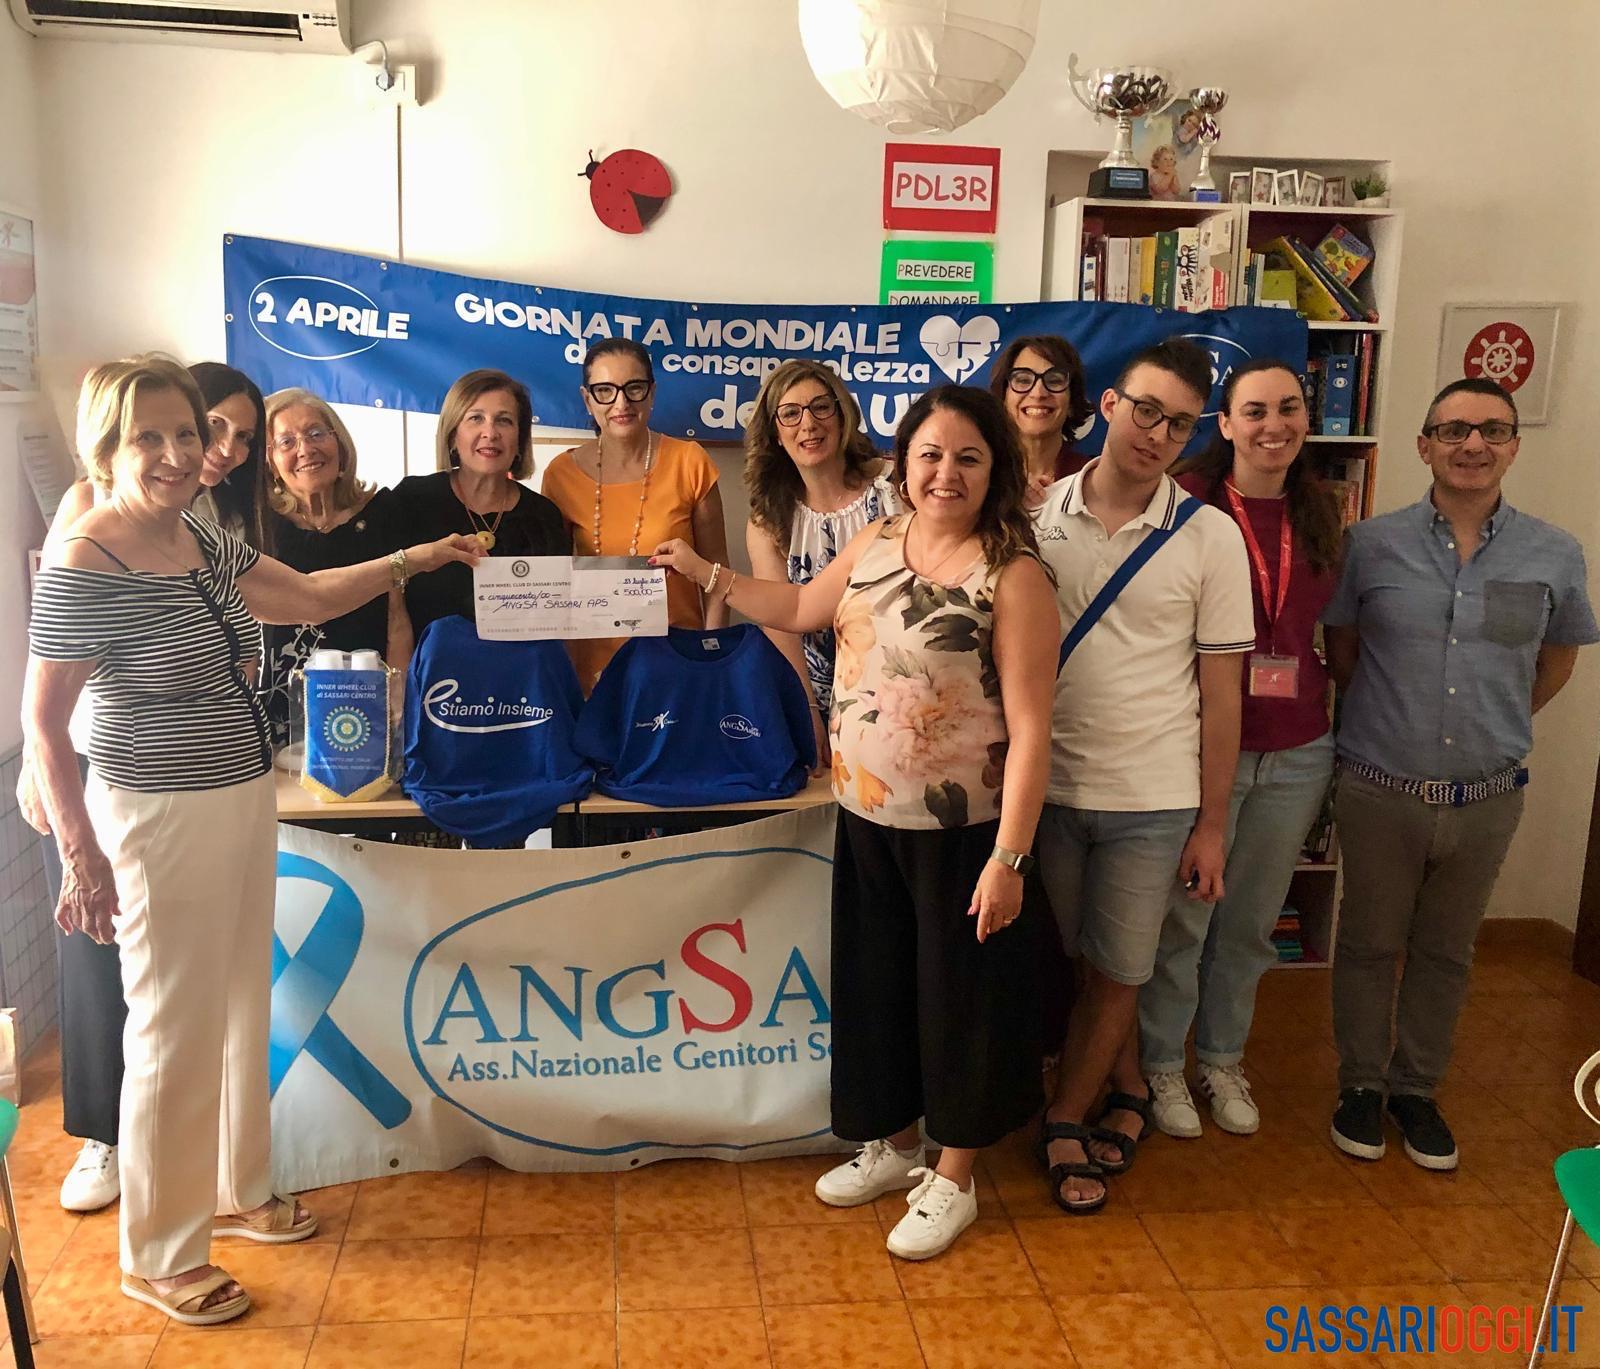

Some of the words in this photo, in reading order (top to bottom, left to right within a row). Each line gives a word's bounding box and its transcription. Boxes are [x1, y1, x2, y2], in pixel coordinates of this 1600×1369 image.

[896, 172, 987, 202] PDL3R
[897, 264, 973, 279] PREVEDERE
[254, 292, 277, 324] 2
[286, 297, 410, 340] APRILE
[454, 292, 674, 347] GIORNATA
[686, 318, 901, 355] MONDIALE
[494, 599, 538, 612] ANGSA
[544, 599, 583, 609] SASSARI
[587, 598, 609, 608] APS
[497, 696, 554, 719] Insieme
[422, 918, 832, 1046] ANGSA
[673, 1037, 798, 1071] Genitori
